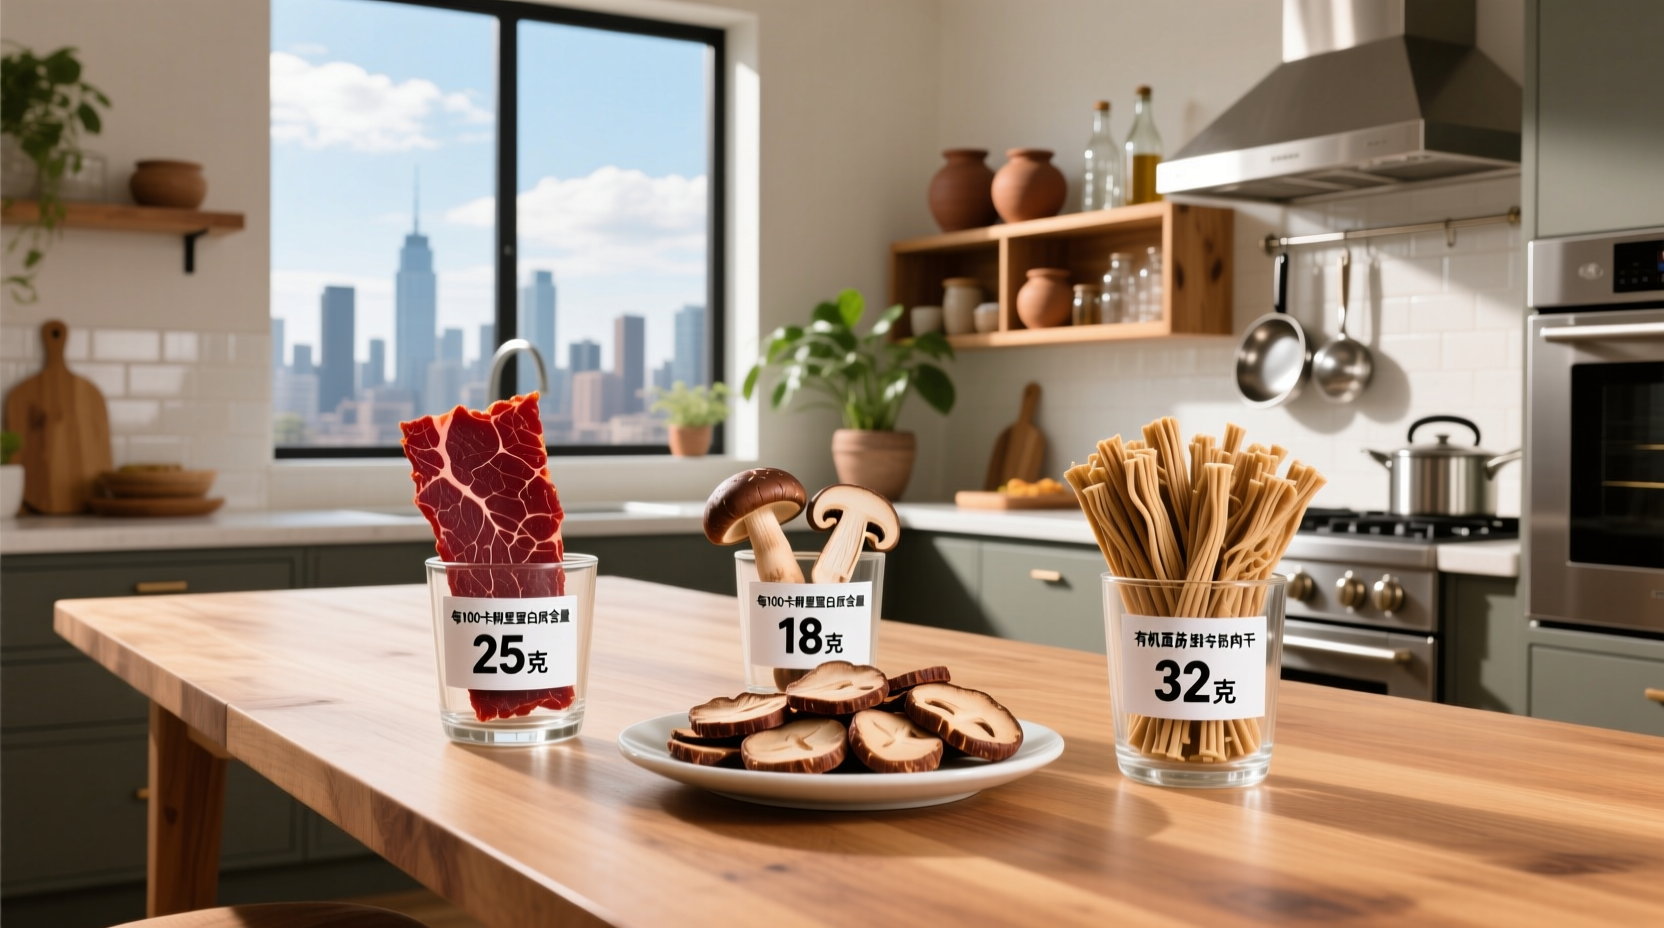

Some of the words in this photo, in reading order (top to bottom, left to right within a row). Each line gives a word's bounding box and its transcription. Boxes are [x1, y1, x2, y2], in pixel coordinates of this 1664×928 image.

[472, 633, 549, 675] 25克
[778, 616, 844, 655] 18克
[1154, 659, 1237, 705] 32克
